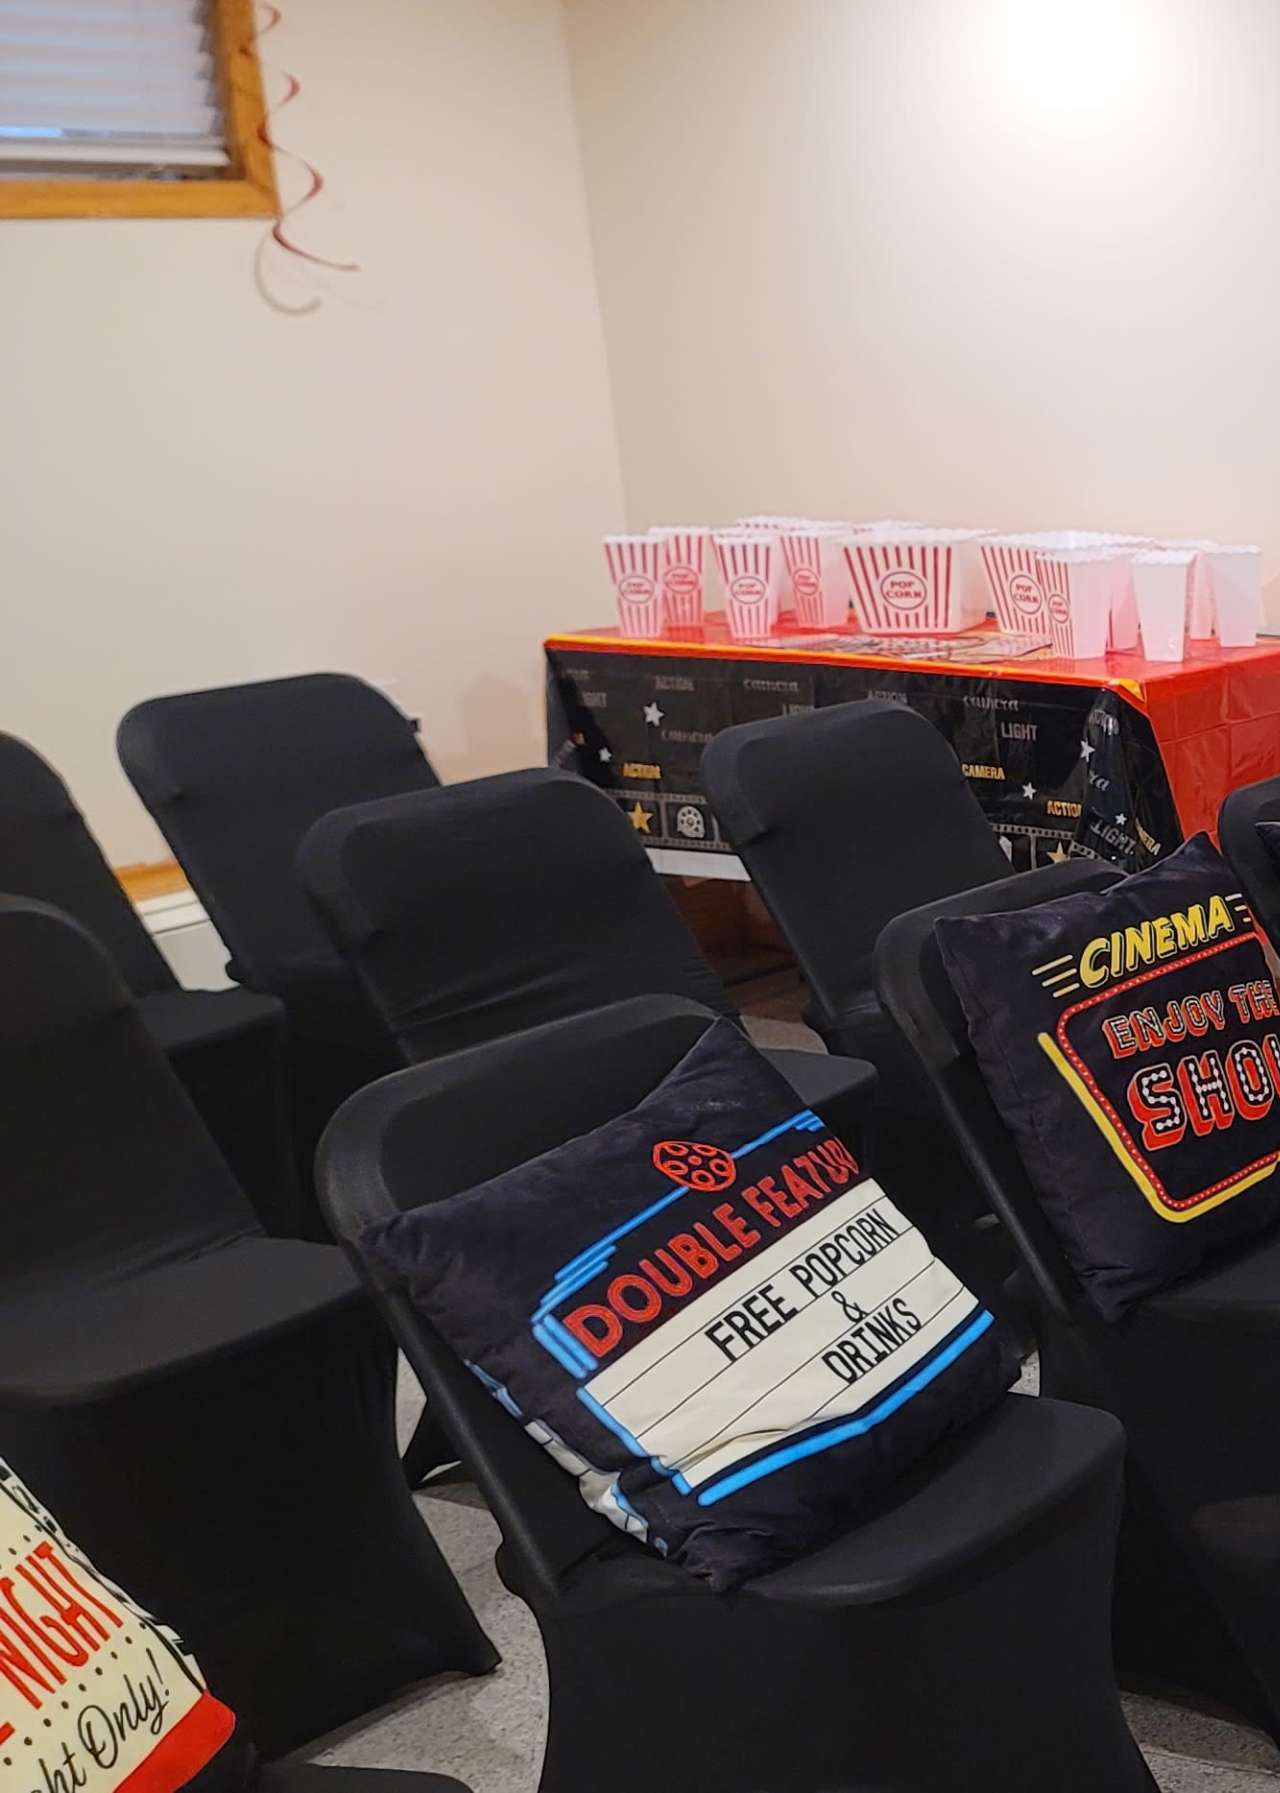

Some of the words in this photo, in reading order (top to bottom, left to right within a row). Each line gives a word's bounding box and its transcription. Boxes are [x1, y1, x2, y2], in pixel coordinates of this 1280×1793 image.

[961, 764, 1006, 780] CAMERA
[1001, 723, 1038, 741] LIGHT
[1080, 895, 1235, 989] CINEMA
[1102, 990, 1225, 1059] ENJOY
[562, 1203, 762, 1359] DOUBLE
[704, 1283, 799, 1362] FREE
[788, 1207, 901, 1298] POPCORN
[830, 1290, 867, 1323] &
[821, 1298, 922, 1384] DRINKS
[78, 1647, 170, 1769] Only!
